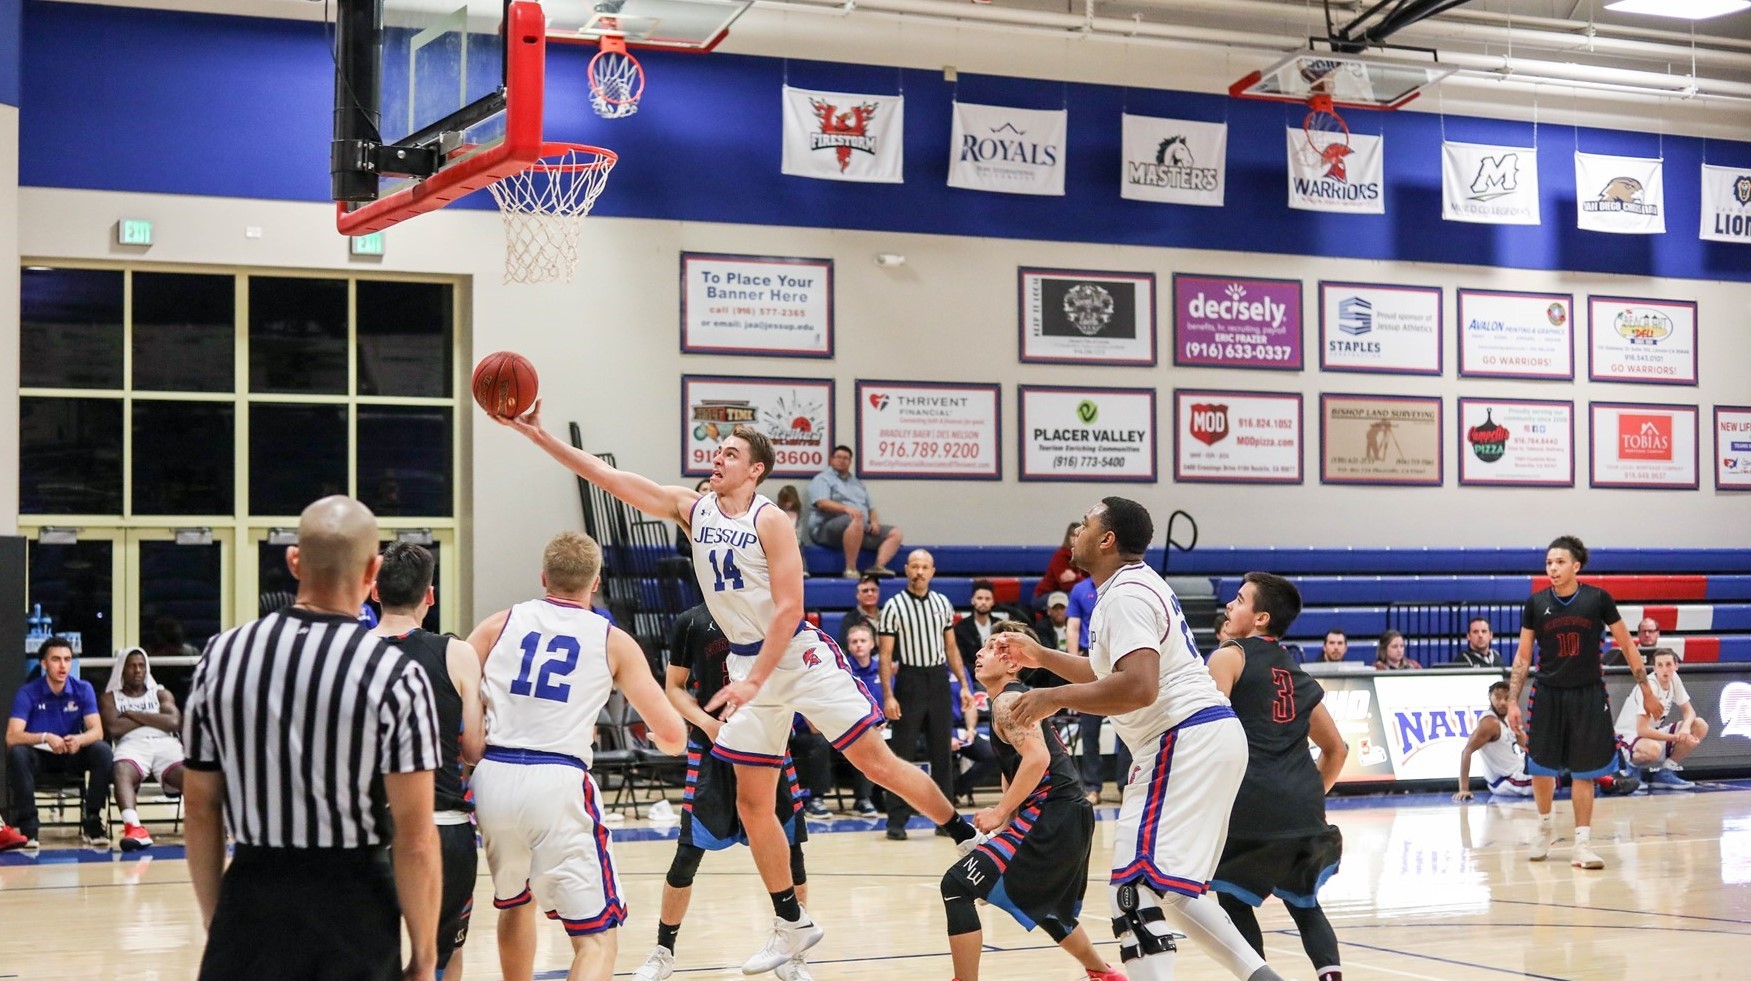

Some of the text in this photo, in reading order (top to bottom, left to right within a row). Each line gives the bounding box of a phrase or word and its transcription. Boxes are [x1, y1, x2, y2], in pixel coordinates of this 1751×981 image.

[811, 132, 876, 153] FIRESTORM
[960, 134, 1057, 167] ROYALS
[1294, 177, 1378, 200] WARRIORS
[701, 271, 814, 288] To Place Your
[707, 287, 808, 302] Banner Here
[1215, 333, 1267, 344] ERIC FRAZER
[1186, 342, 1291, 360] (916) 633-0337
[1329, 340, 1381, 353] STAPLES
[1482, 356, 1496, 365] GO
[1611, 364, 1624, 372] GO
[897, 396, 968, 407] THRIVENT
[1331, 408, 1364, 417] BISHOP
[1366, 409, 1389, 417] LAND
[1194, 411, 1225, 432] MOD
[1720, 422, 1737, 431] NEW
[1034, 428, 1146, 442] PLACER VALLEY
[1622, 434, 1668, 448] TOBIAS
[879, 441, 980, 459] 916.789.9200
[1474, 444, 1505, 454] PIZZA
[776, 451, 823, 465] 3600
[1053, 456, 1078, 468] (916)
[694, 526, 758, 549] JESSUP
[708, 549, 744, 592] 14
[1556, 632, 1580, 657] 10
[510, 631, 581, 703] 12
[1271, 667, 1297, 724] 3
